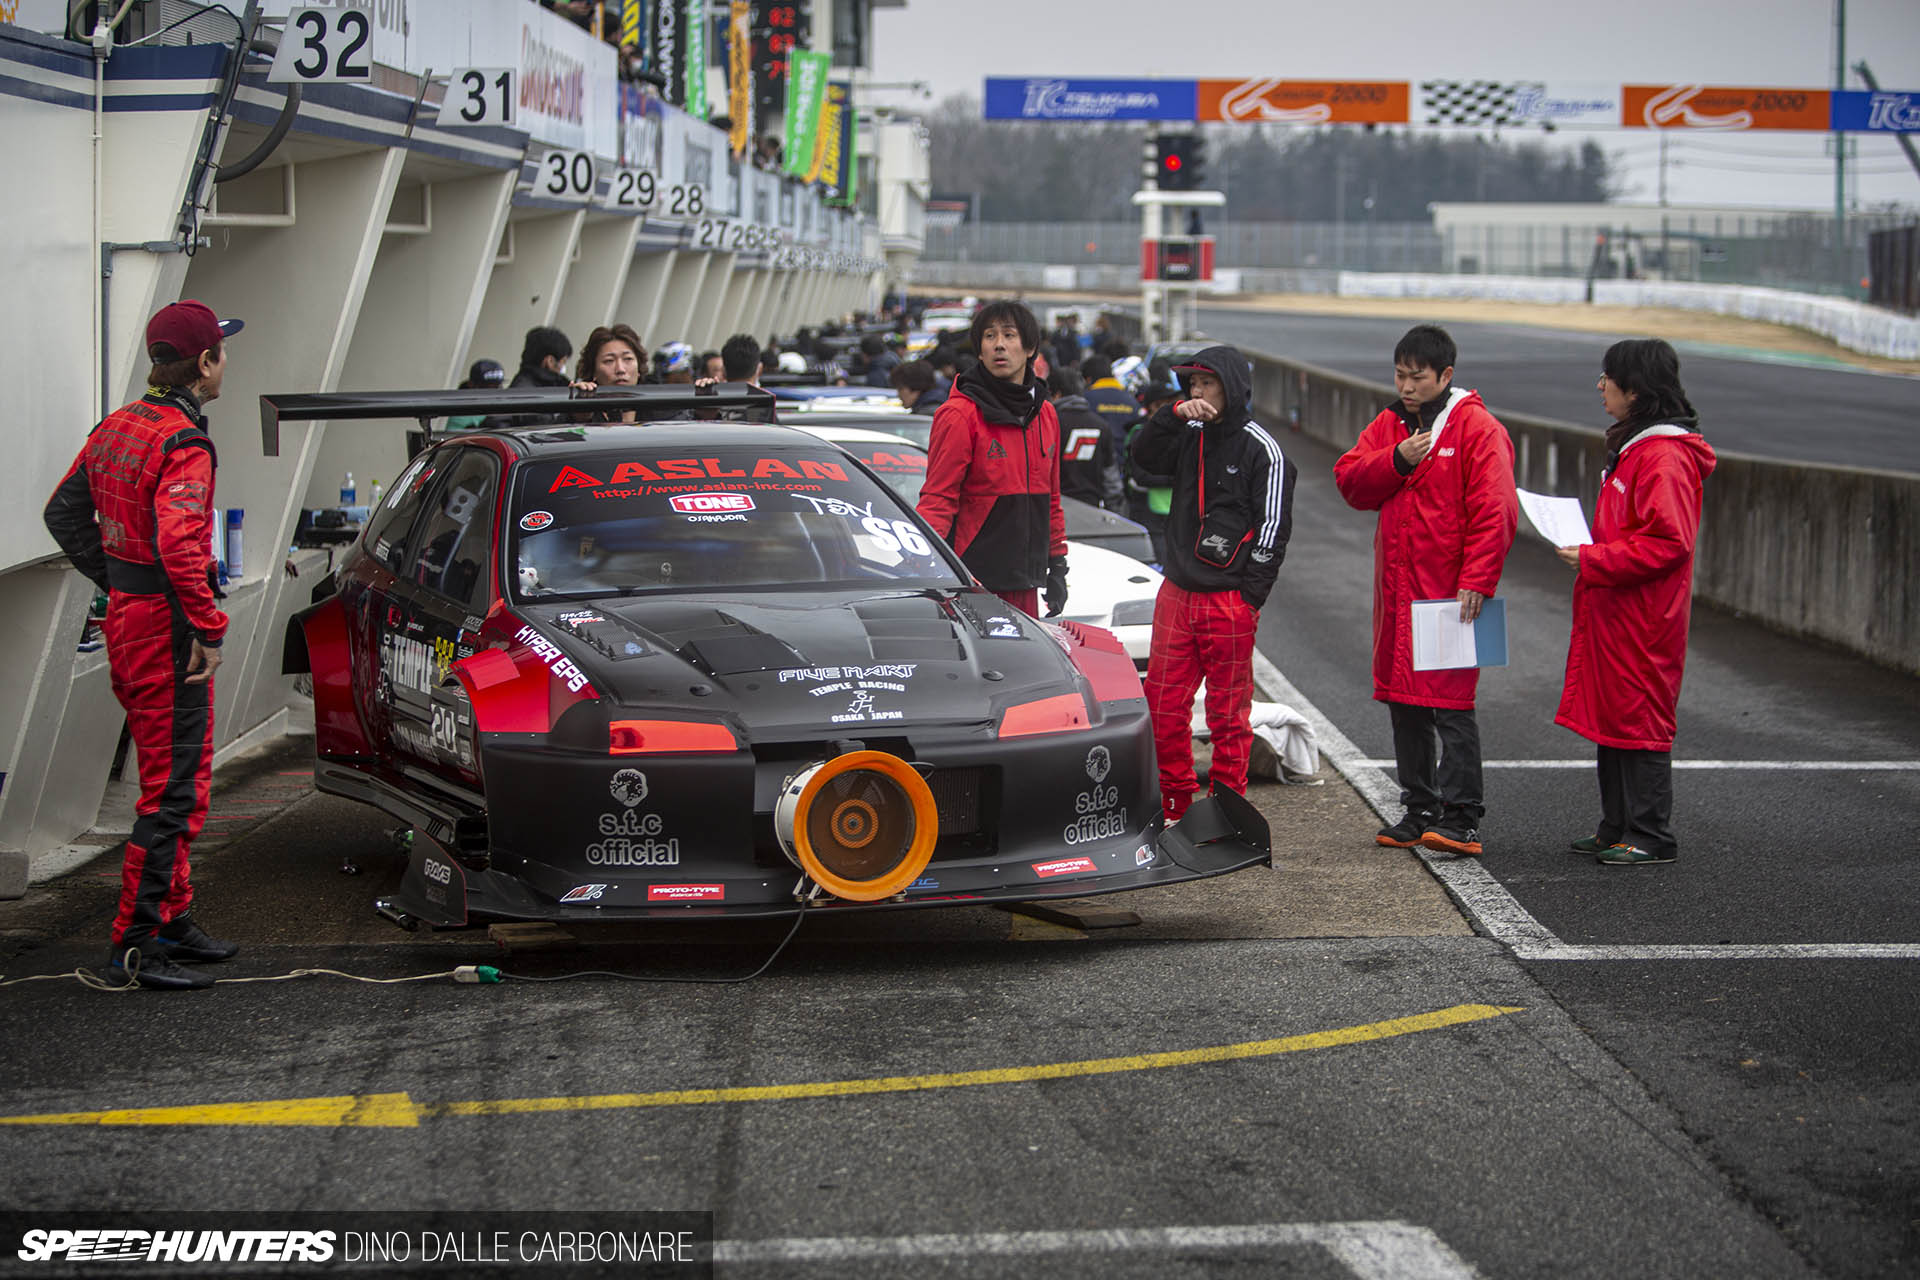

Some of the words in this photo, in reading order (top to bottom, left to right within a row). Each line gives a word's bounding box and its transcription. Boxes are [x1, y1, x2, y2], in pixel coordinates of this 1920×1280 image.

[294, 11, 369, 79] 32
[460, 71, 510, 122] 31
[547, 153, 593, 194] 30
[618, 172, 655, 206] 29
[671, 185, 703, 216] 28
[701, 220, 728, 247] 27
[732, 225, 756, 249] 26
[610, 457, 849, 484] ASLAN
[593, 480, 822, 500] http://www.aslan-inc.com
[677, 496, 748, 510] TONE
[394, 634, 434, 695] TEMPLE
[514, 625, 560, 664] HYPER
[550, 654, 589, 693] EPS
[779, 667, 841, 682] FIVE
[809, 682, 853, 696] TEMPLE
[858, 681, 905, 691] RACING
[831, 713, 865, 722] OSAKA
[871, 711, 903, 720] JAPAN
[1075, 784, 1118, 815] s.t.c
[600, 809, 662, 836] s.t.c
[1064, 808, 1126, 845] official
[586, 839, 679, 865] official
[1037, 860, 1090, 871] PROTO-TYPE
[424, 858, 451, 884] RAYS
